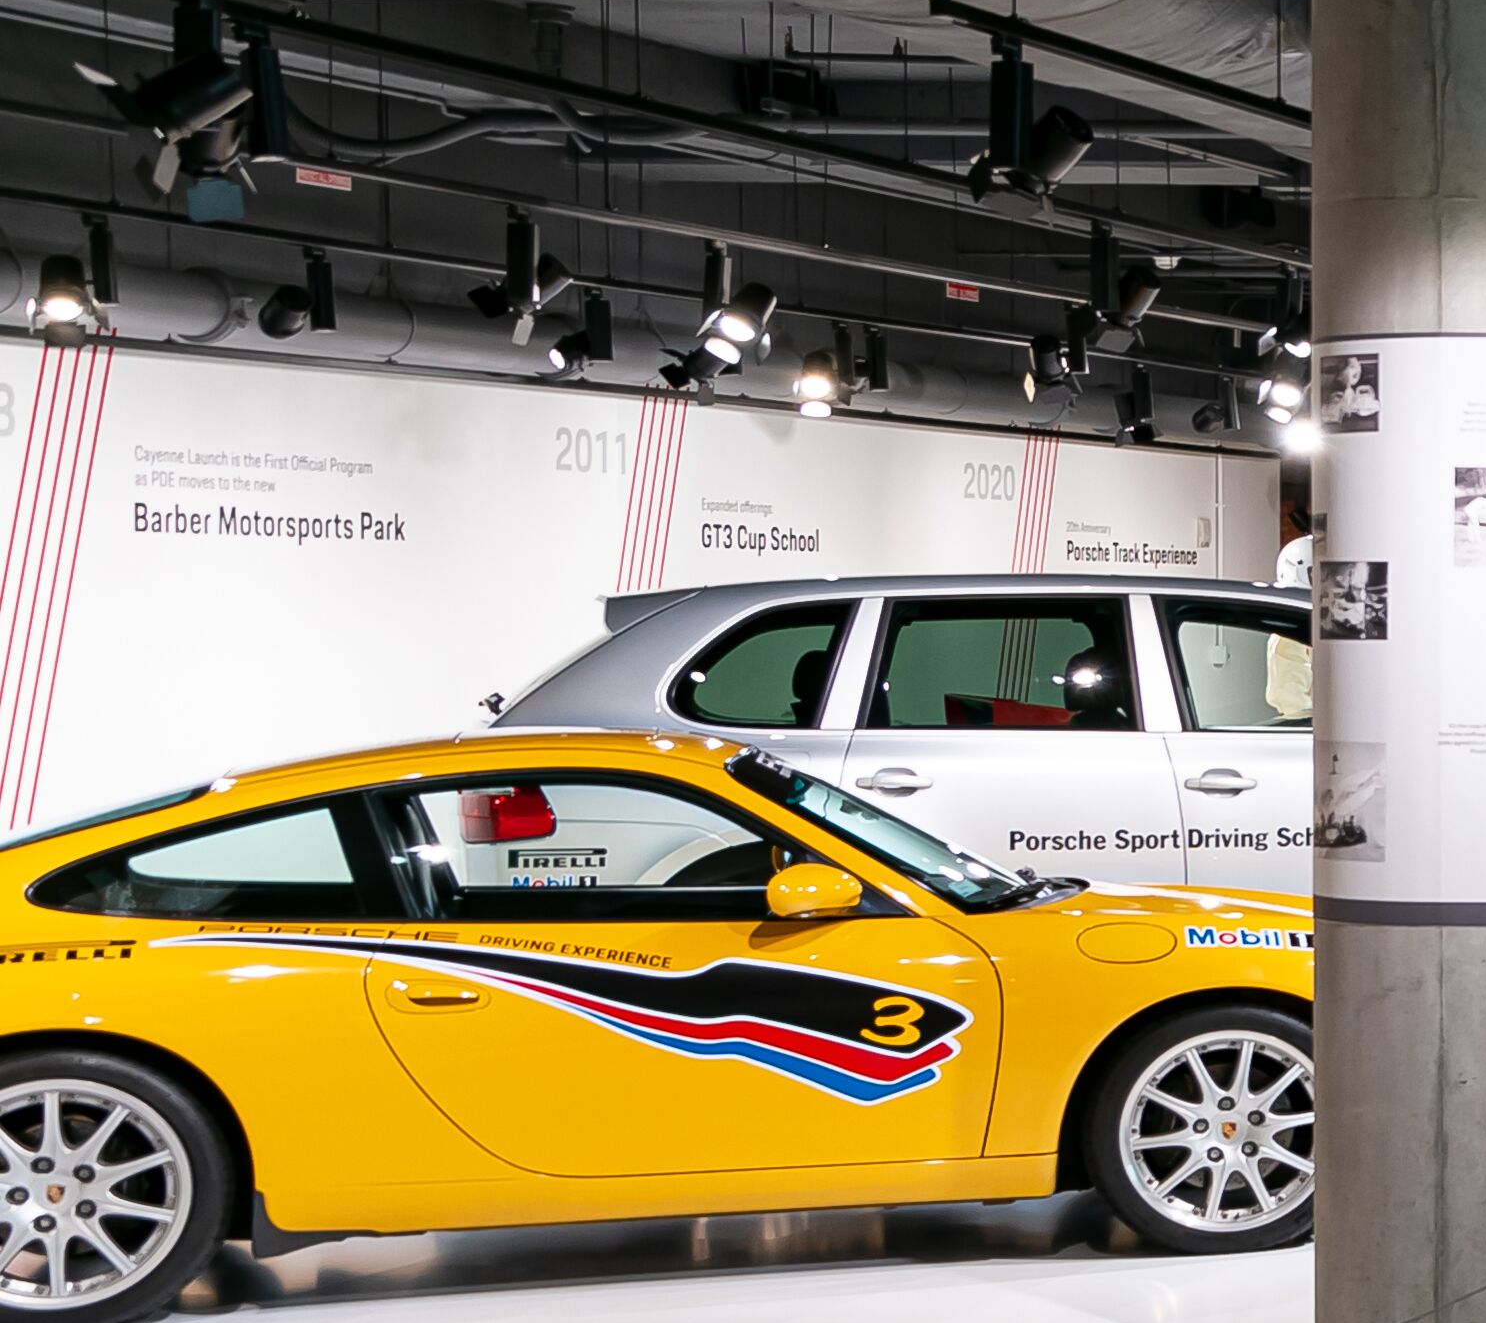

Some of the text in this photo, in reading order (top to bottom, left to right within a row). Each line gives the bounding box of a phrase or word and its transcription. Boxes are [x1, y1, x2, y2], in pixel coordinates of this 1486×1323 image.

[134, 445, 373, 477] Cayenne Launch is the First Official Program
[556, 427, 627, 476] 2011
[135, 475, 147, 486] as
[178, 476, 215, 490] moves
[218, 477, 230, 491] to
[233, 477, 251, 491] the
[254, 480, 275, 492] new
[963, 462, 1016, 501] 2020
[702, 498, 738, 513] Expanded
[134, 502, 405, 546] Barber Motorsports Park
[702, 523, 820, 556] GT3 Cup School
[1067, 540, 1198, 568] Porsche Track Experience
[1010, 830, 1106, 851] Porsche
[1115, 829, 1180, 853] Sport
[1188, 828, 1269, 851] Driving
[508, 848, 607, 868] PIRELLI
[199, 924, 459, 943] PORSCHE
[1188, 927, 1280, 947] Mobil
[479, 934, 674, 969] DRIVING EXPERIENCE
[860, 996, 925, 1046] 3
